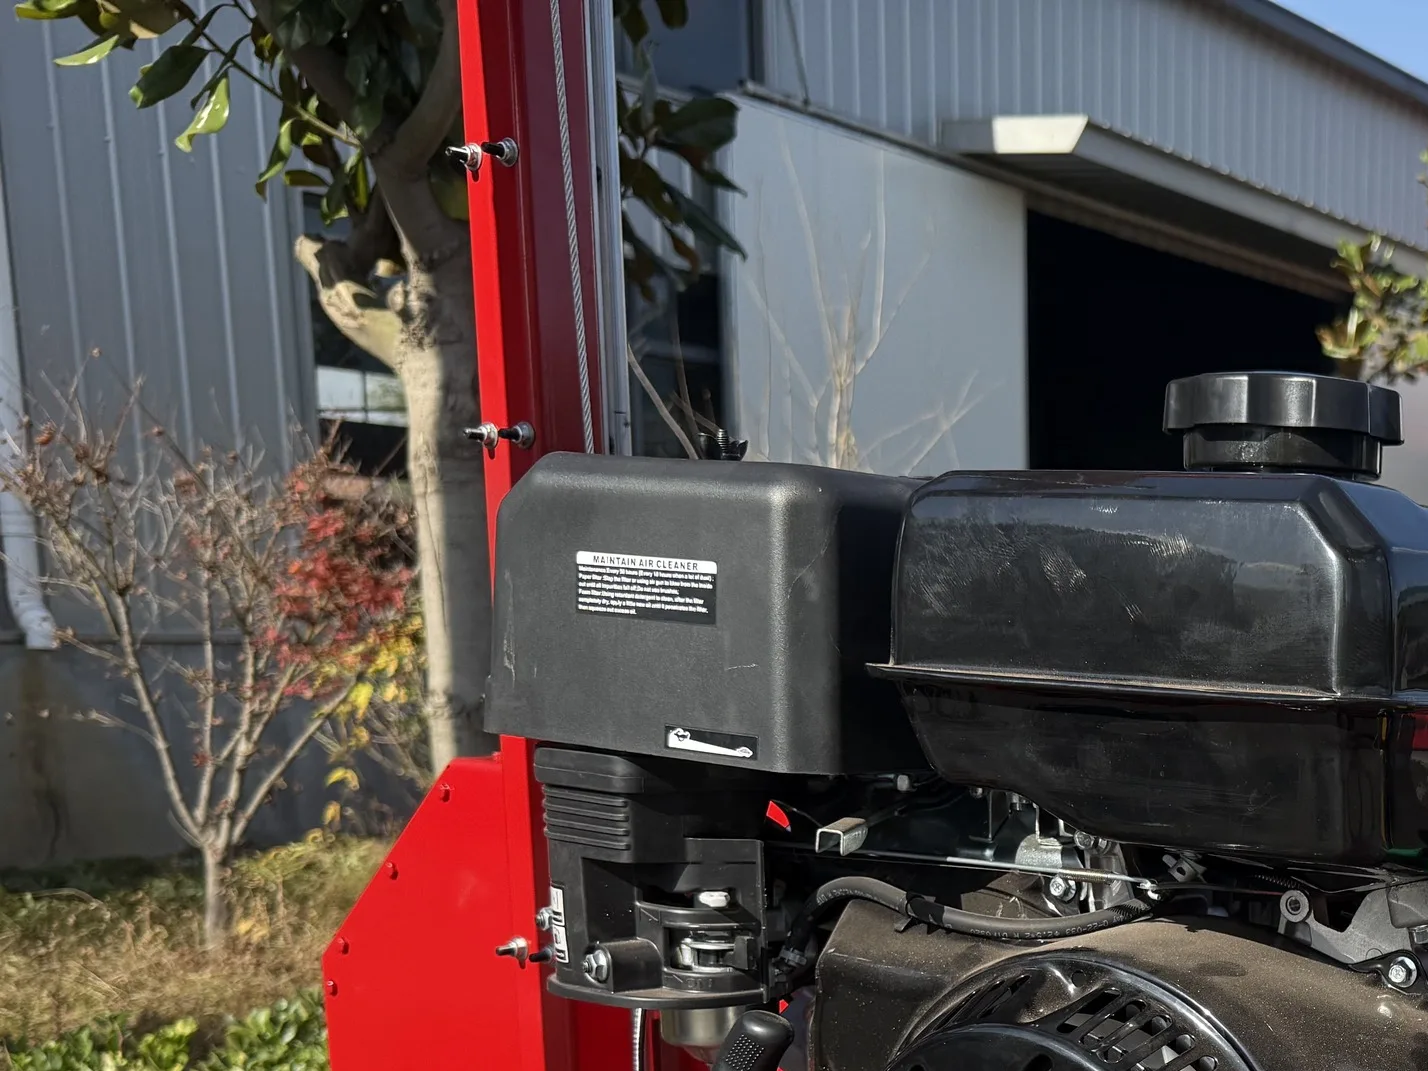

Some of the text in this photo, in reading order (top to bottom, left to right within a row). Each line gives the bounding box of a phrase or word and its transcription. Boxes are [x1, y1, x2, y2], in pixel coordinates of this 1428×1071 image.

[593, 555, 698, 571] MAINTAIN AIR CLEANER
